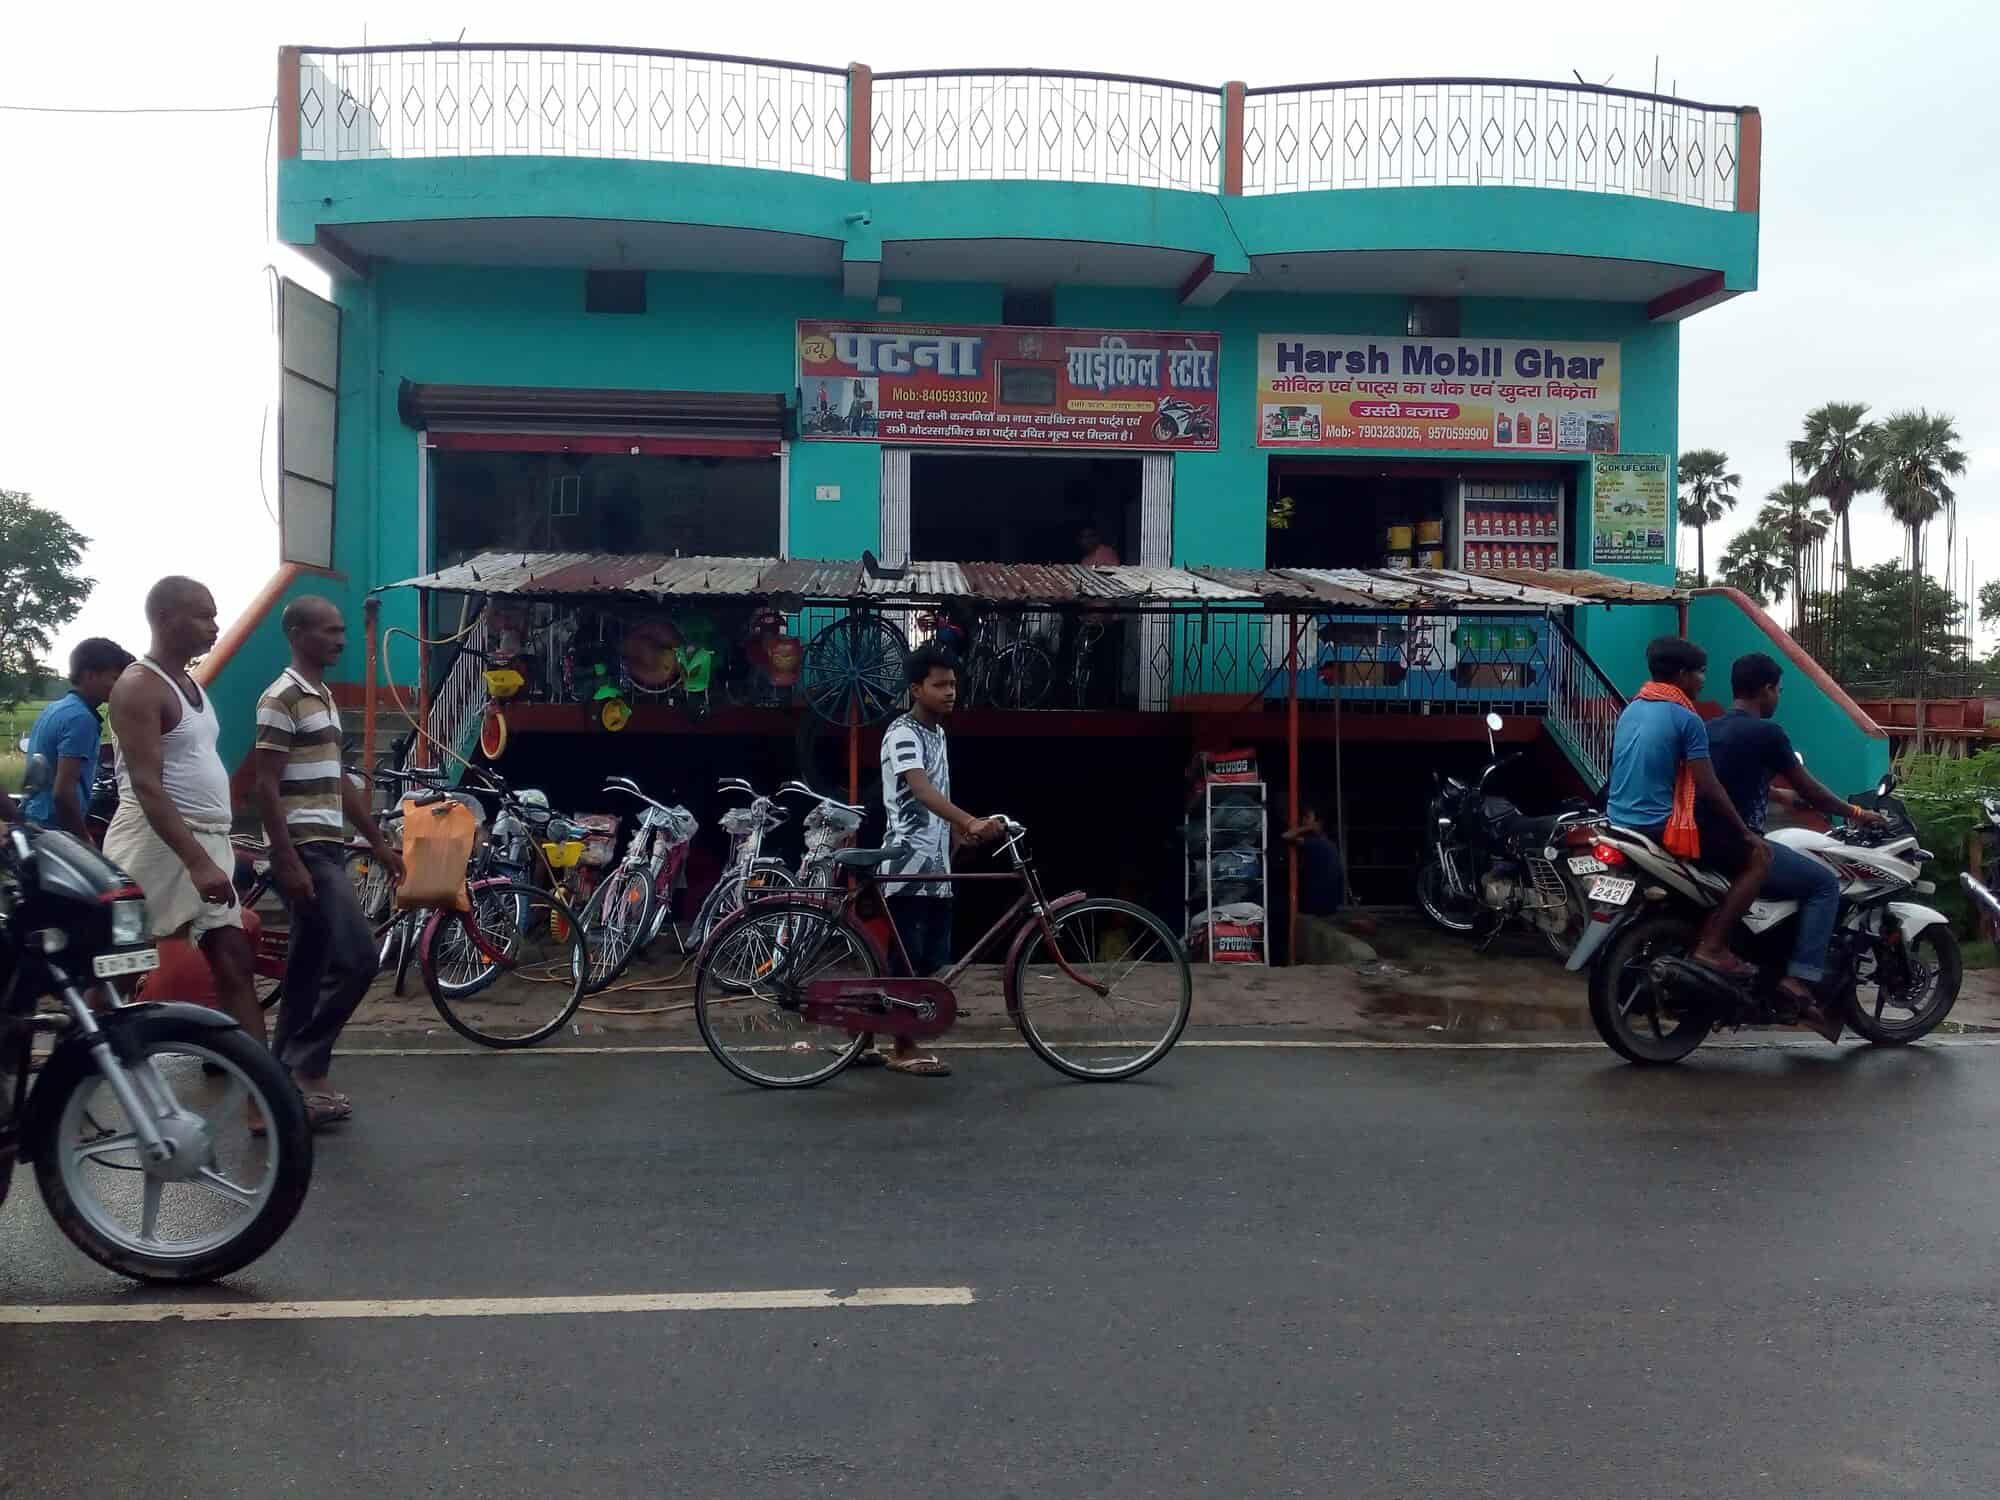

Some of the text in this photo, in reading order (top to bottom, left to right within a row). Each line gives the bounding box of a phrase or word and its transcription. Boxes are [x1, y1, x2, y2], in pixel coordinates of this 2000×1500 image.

[829, 332, 983, 377] पटना
[1064, 335, 1161, 391] साईकिल
[1167, 338, 1215, 388] स्टोर
[1277, 342, 1390, 375] Harsh
[1514, 348, 1605, 380] Ghar
[1403, 382, 1427, 395] का
[1430, 378, 1466, 396] थोक
[1470, 379, 1496, 397] एवं
[1498, 383, 1543, 403] खुदरा
[996, 413, 1010, 423] का
[976, 427, 990, 437] का
